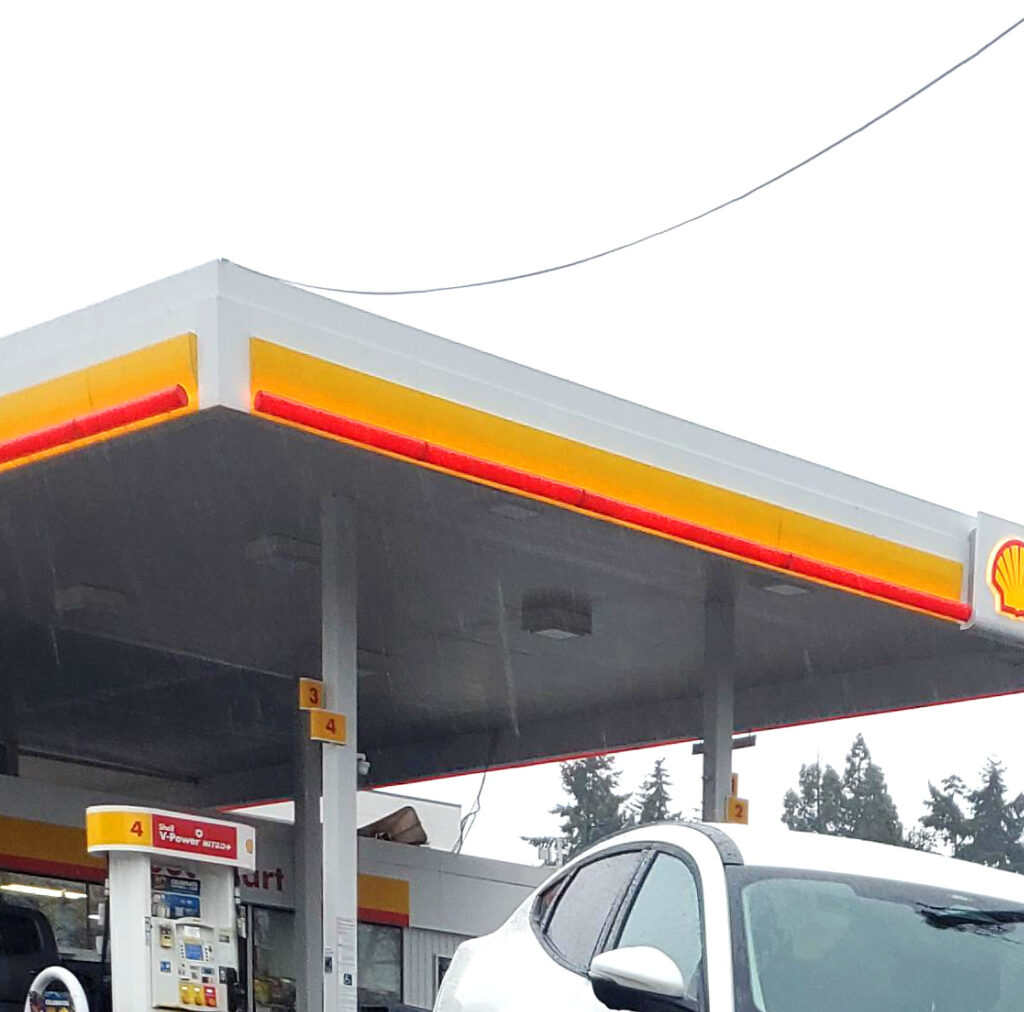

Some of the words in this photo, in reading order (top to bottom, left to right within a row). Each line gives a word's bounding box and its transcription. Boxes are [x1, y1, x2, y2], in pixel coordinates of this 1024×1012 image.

[309, 687, 318, 705] 3
[326, 718, 337, 735] 4
[734, 804, 743, 818] 2
[130, 820, 143, 837] 4
[158, 823, 175, 832] Shell
[159, 831, 202, 846] V-Power
[237, 867, 284, 891] art
